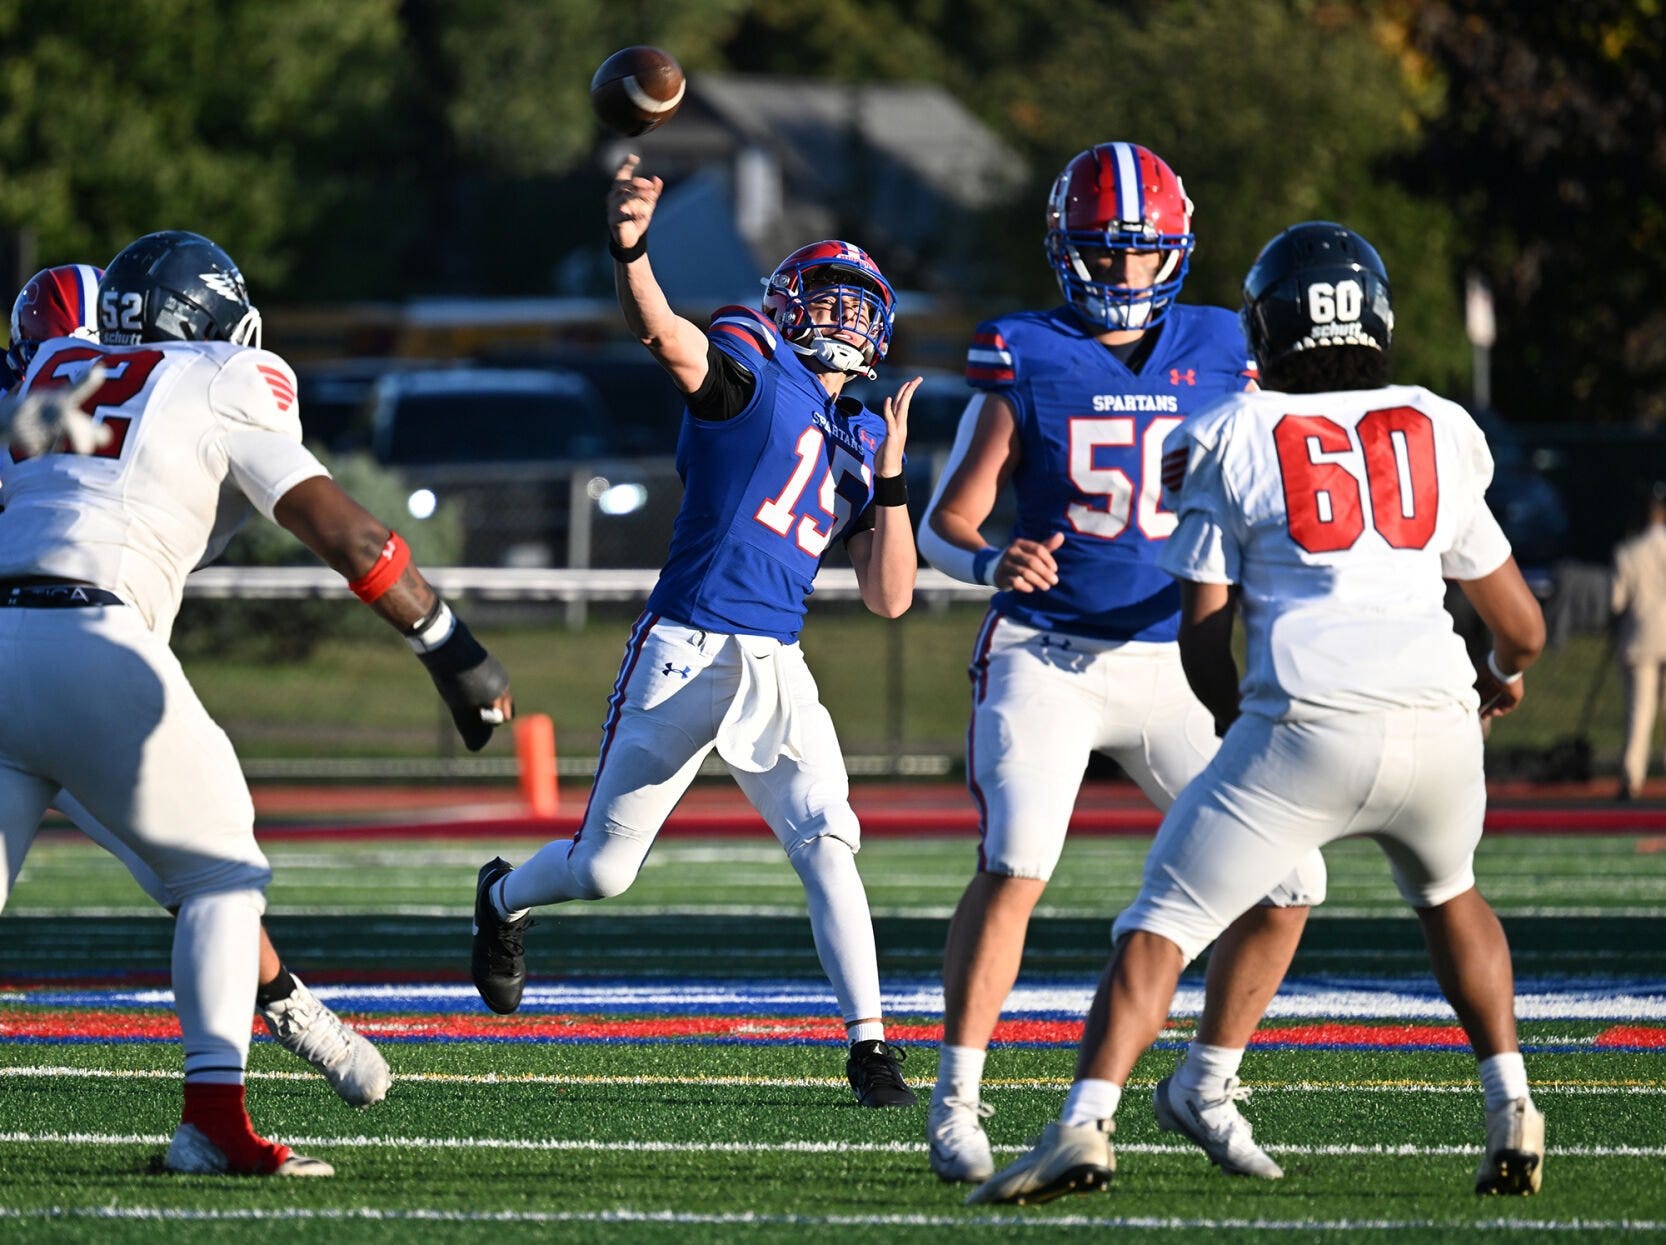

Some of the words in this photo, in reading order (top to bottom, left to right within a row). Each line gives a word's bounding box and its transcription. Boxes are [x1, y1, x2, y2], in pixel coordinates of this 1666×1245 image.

[102, 291, 142, 330] 52
[1308, 279, 1363, 324] 60
[103, 331, 142, 345] schutt
[1092, 394, 1178, 412] SPARTANS
[812, 411, 864, 456] SPARTANS
[753, 424, 872, 559] 15
[1272, 405, 1440, 554] 60
